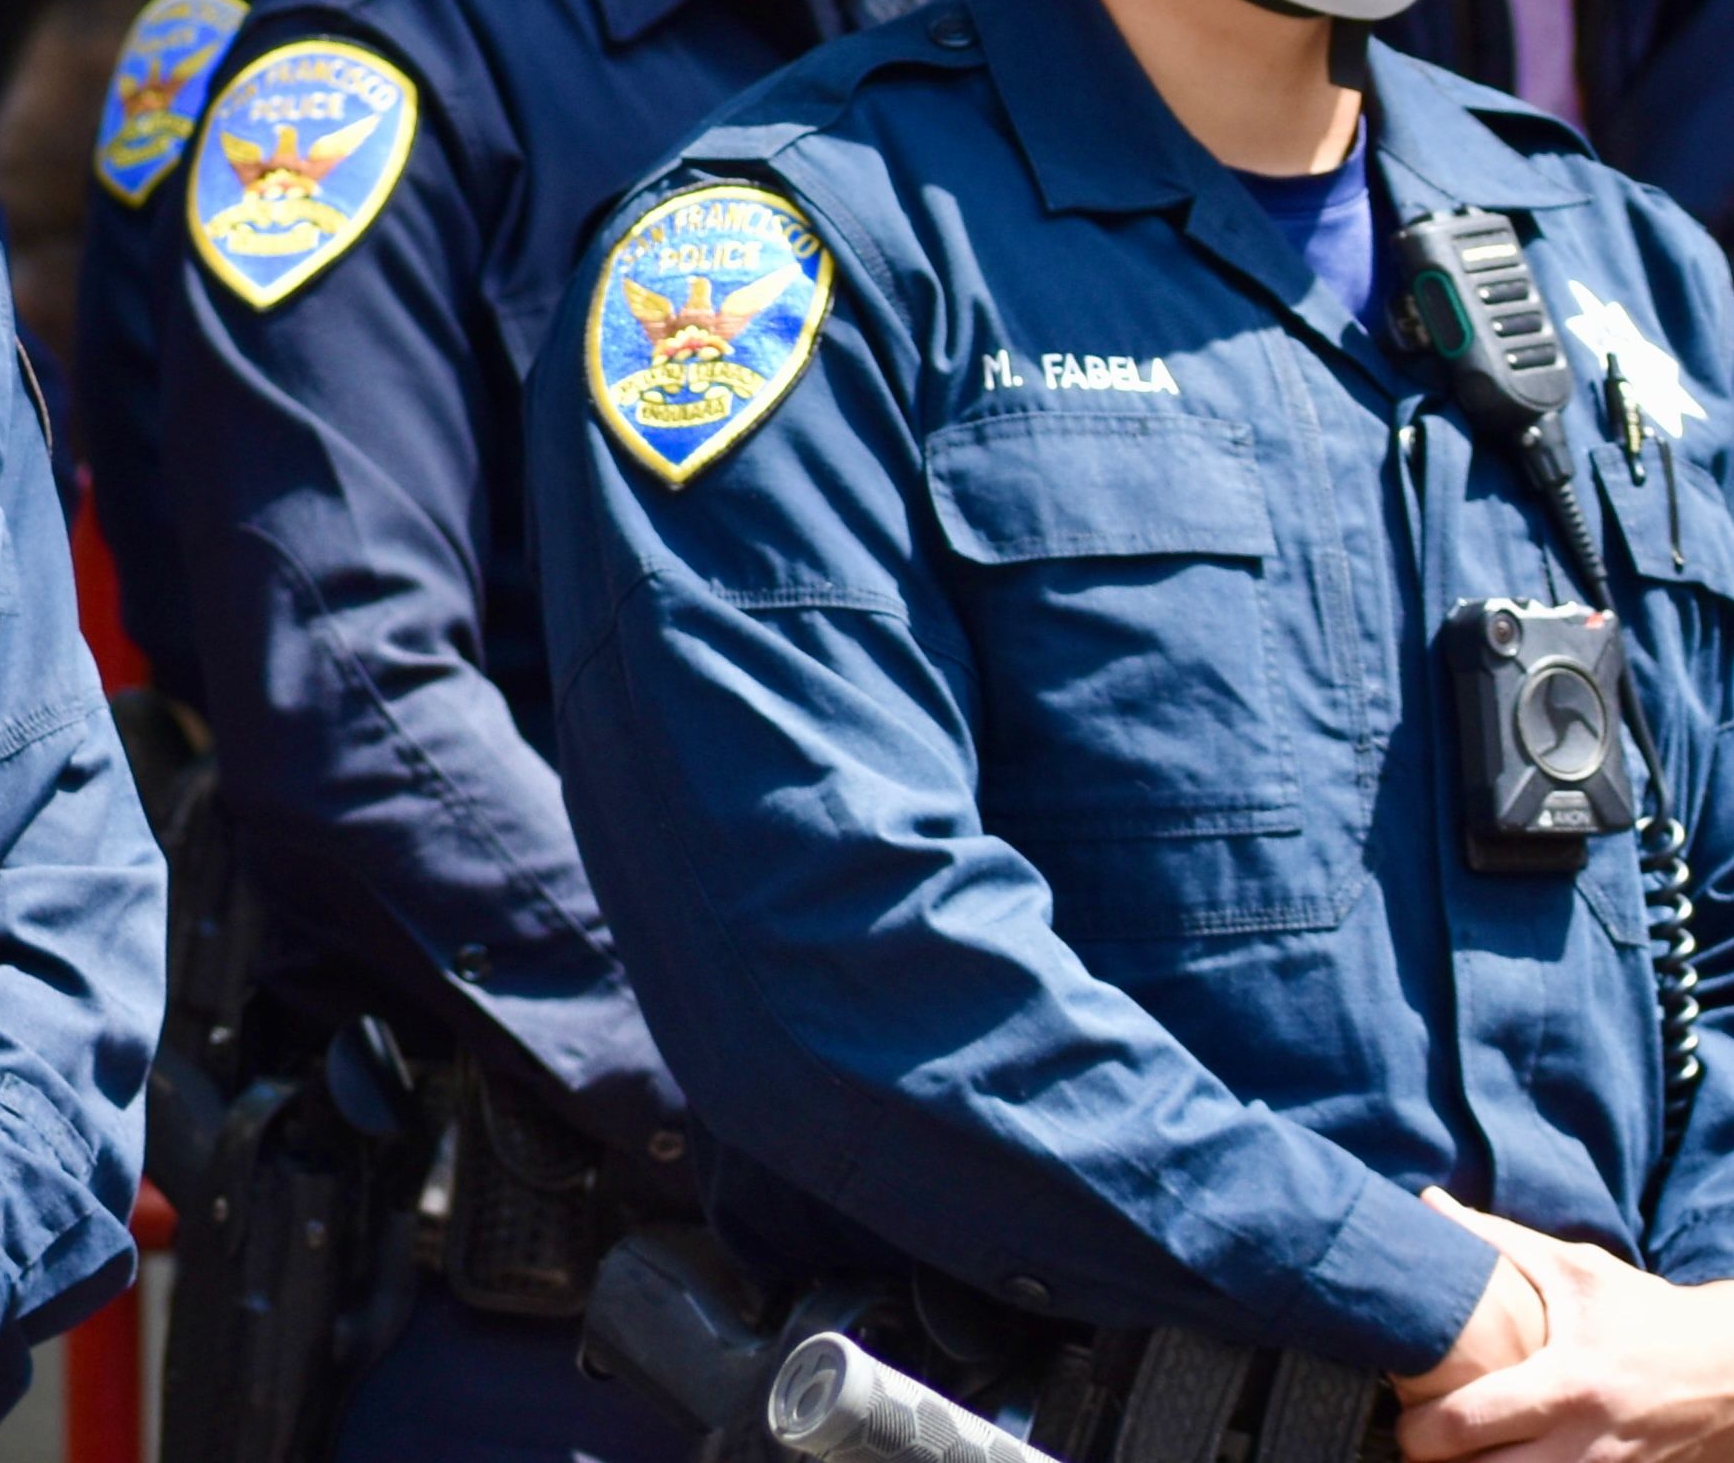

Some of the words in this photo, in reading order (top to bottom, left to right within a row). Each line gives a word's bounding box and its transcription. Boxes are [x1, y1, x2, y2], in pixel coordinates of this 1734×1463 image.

[249, 92, 347, 122] POLICE
[675, 202, 820, 259] FRANCISCO
[659, 241, 763, 273] POLICE
[982, 348, 1024, 391] M.
[1041, 352, 1180, 395] FABELA
